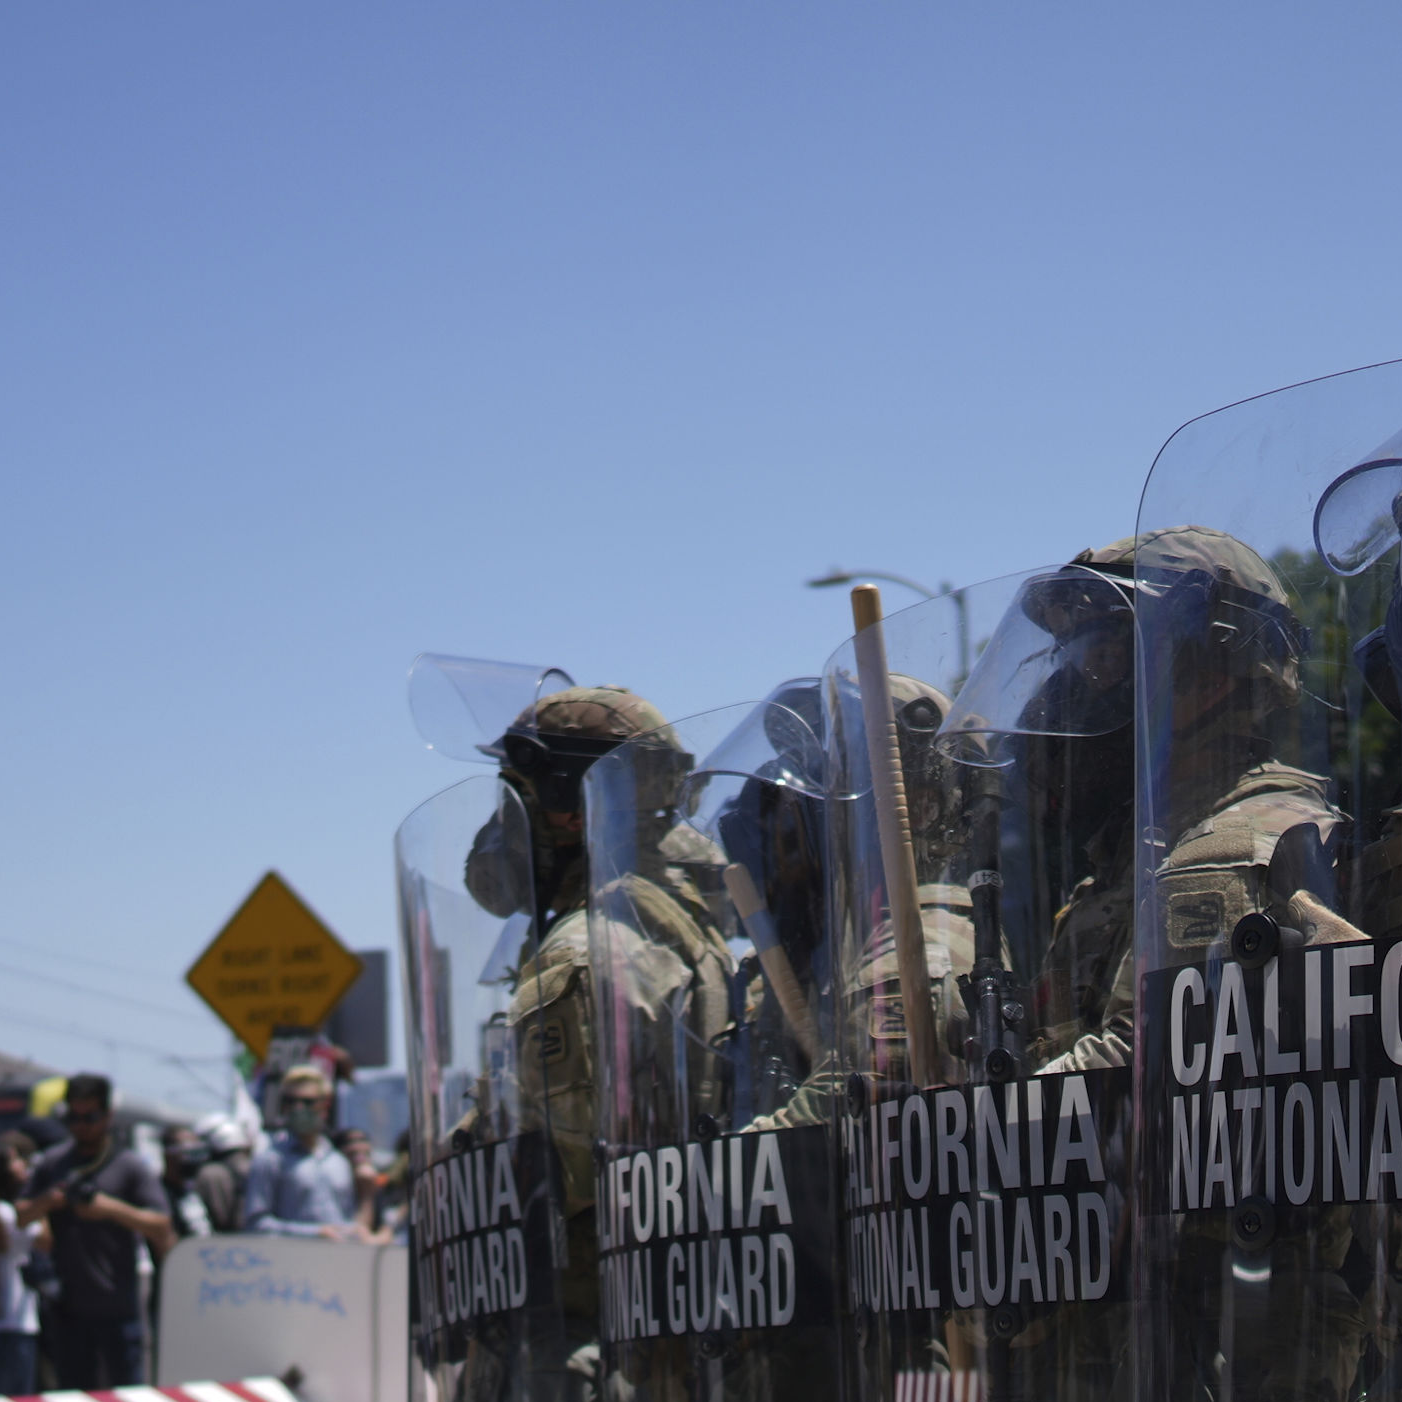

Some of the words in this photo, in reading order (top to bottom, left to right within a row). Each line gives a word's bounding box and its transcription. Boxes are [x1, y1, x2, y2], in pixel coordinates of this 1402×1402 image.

[442, 1227, 528, 1325] GUARD
[667, 1233, 796, 1336] GUARD
[949, 1192, 1111, 1309] GUARD
